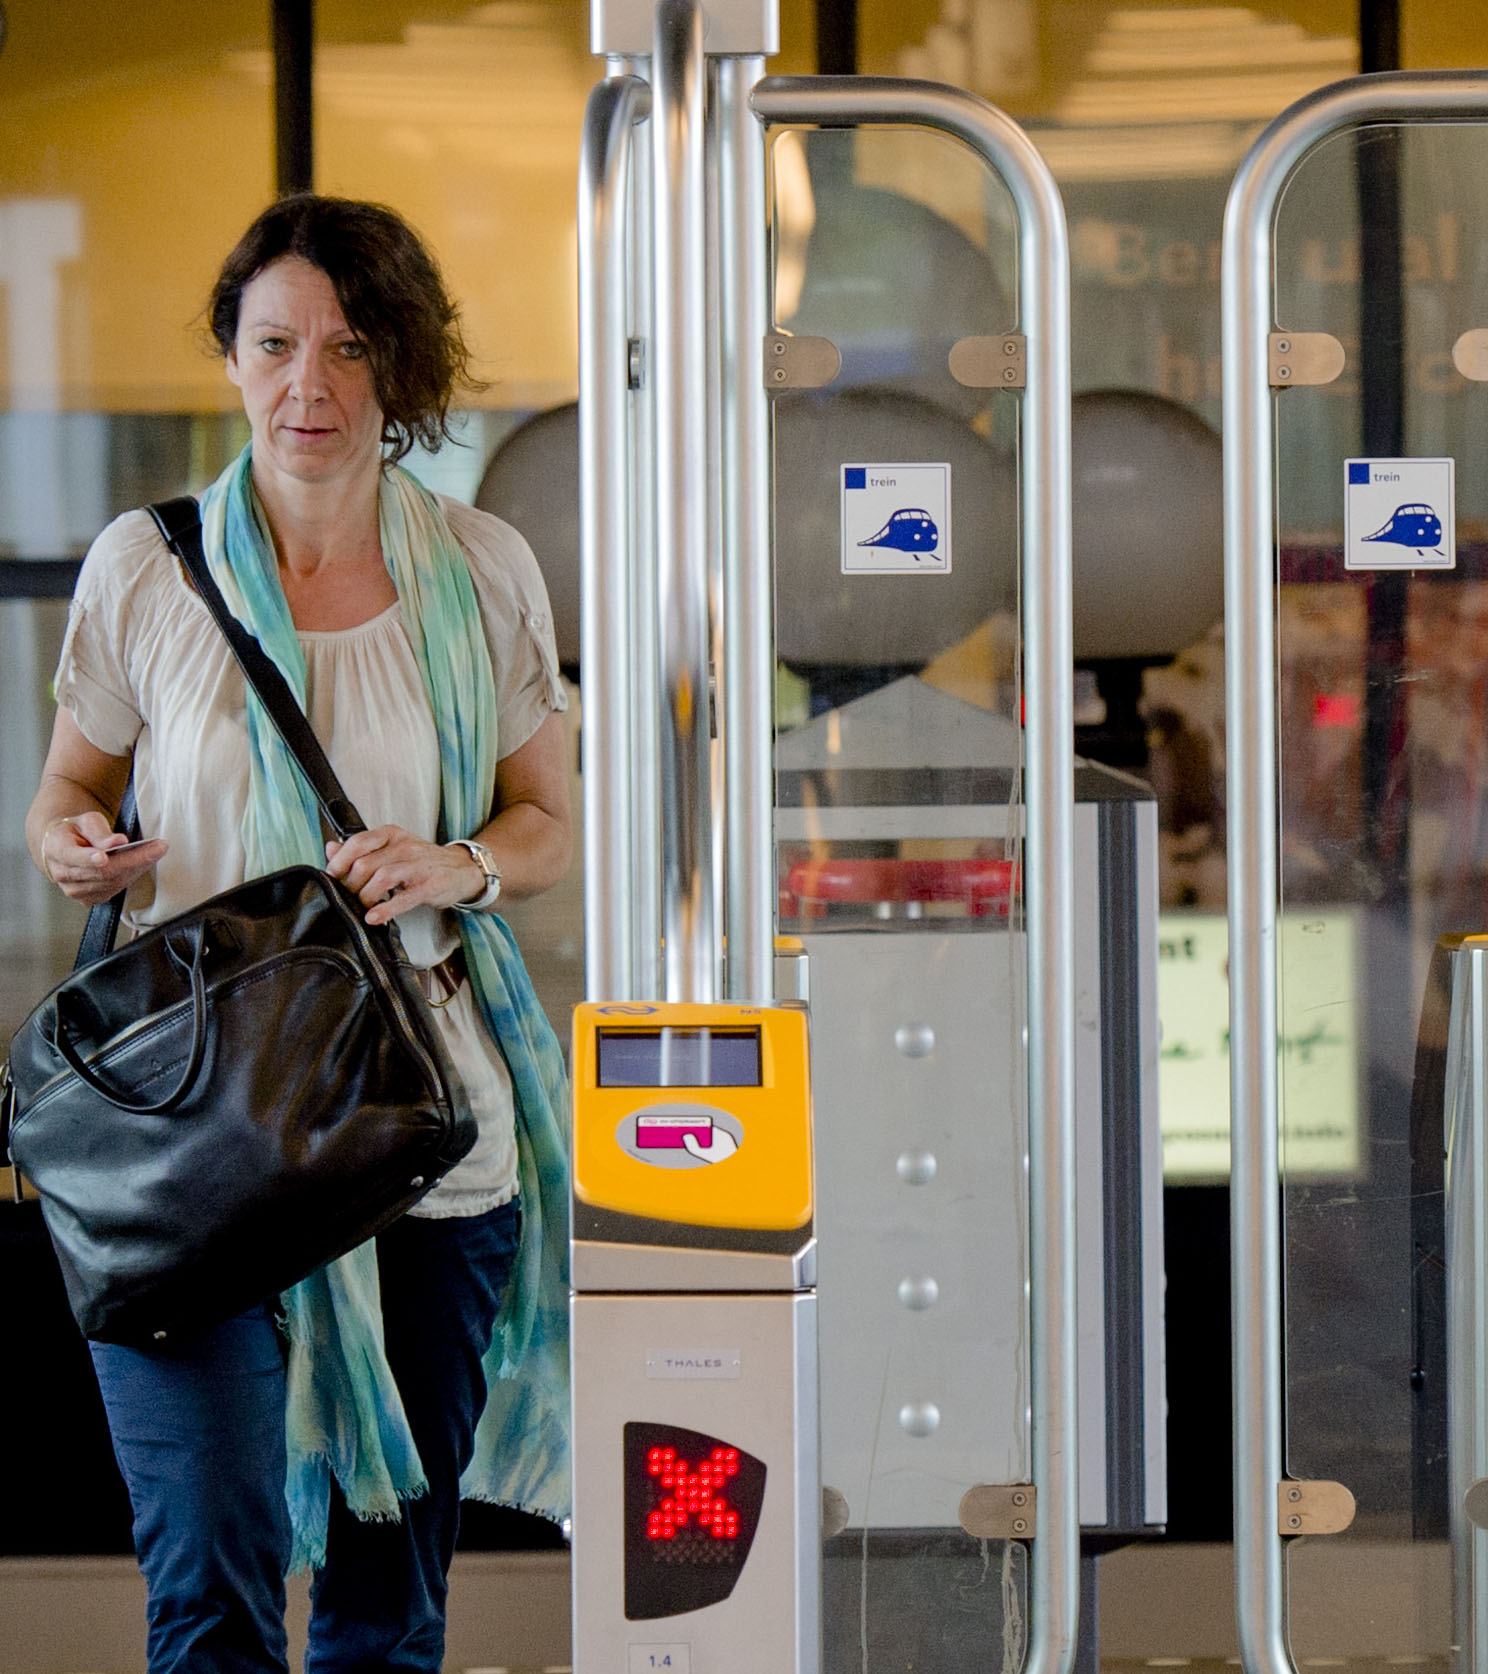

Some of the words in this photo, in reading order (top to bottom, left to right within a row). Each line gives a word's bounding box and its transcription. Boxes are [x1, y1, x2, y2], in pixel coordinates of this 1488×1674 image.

[870, 476, 897, 487] trein
[1373, 472, 1401, 482] trein
[665, 1359, 722, 1368] THALES
[649, 1655, 672, 1668] 1.4
